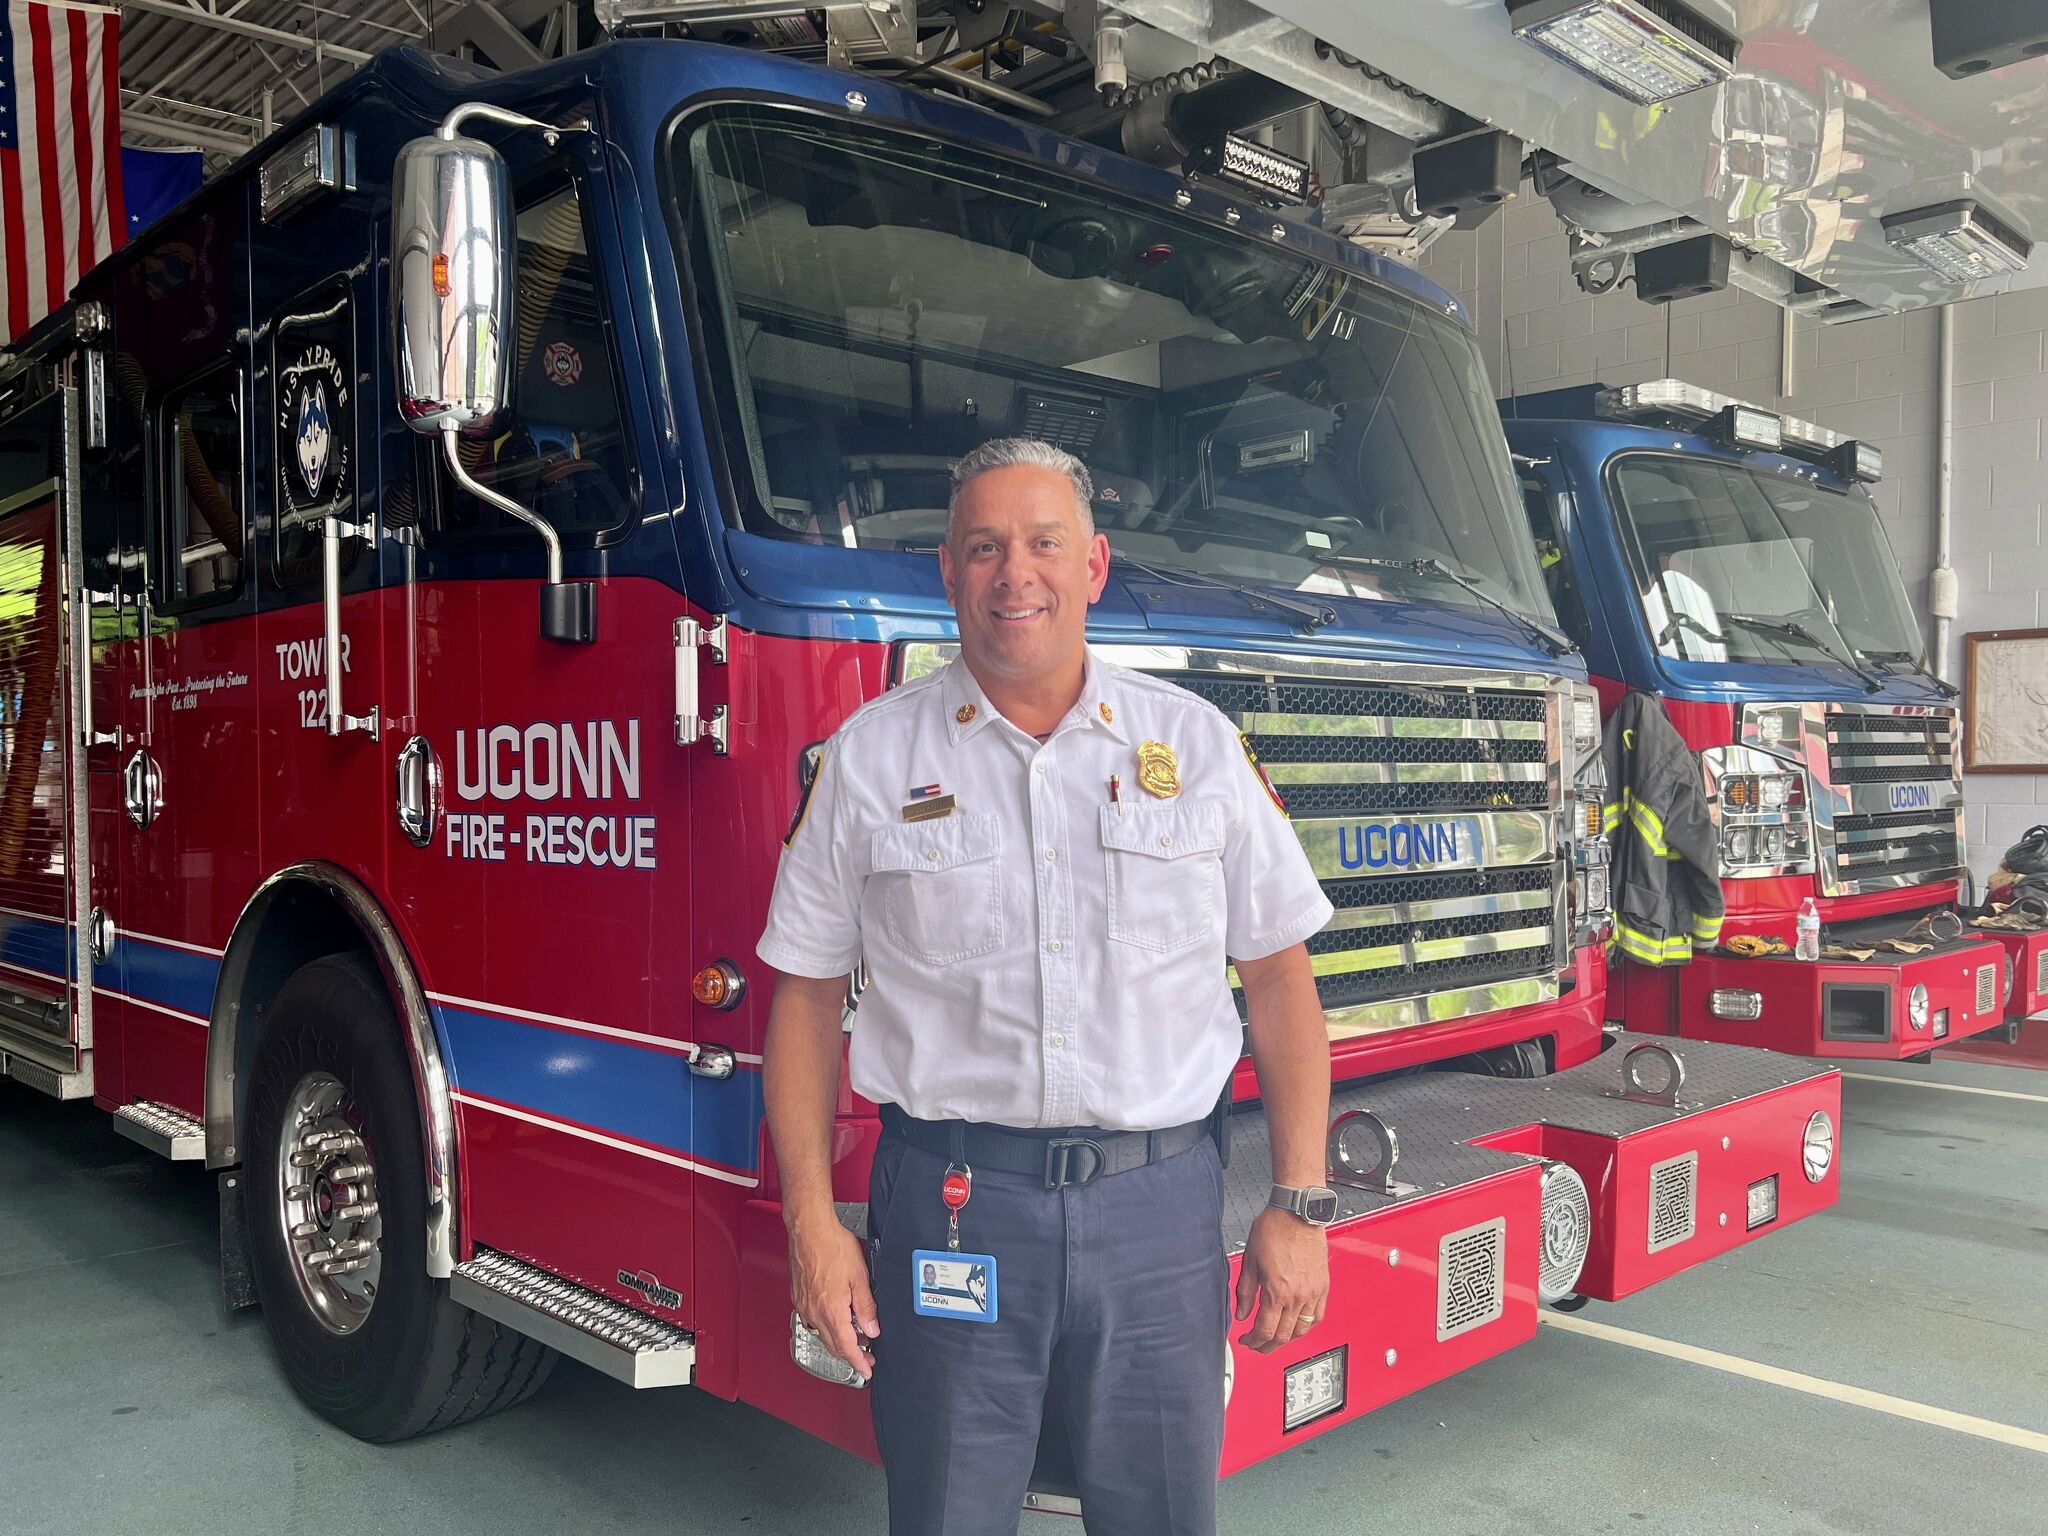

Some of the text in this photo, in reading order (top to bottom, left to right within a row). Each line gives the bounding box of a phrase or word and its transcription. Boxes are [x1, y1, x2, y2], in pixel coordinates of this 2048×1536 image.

[307, 521, 316, 531] OF
[317, 444, 348, 528] CNECTICUT
[275, 633, 352, 681] TOWR
[185, 676, 214, 694] Protecting
[215, 674, 225, 688] the
[226, 671, 248, 688] Future
[298, 688, 328, 728] 122
[455, 718, 640, 801] UCONN
[1890, 785, 1930, 809] UCONN
[1338, 823, 1457, 870] UCONN
[943, 1186, 966, 1195] UCONN
[617, 1271, 681, 1306] COMMANDER
[921, 1296, 949, 1306] UCONN
